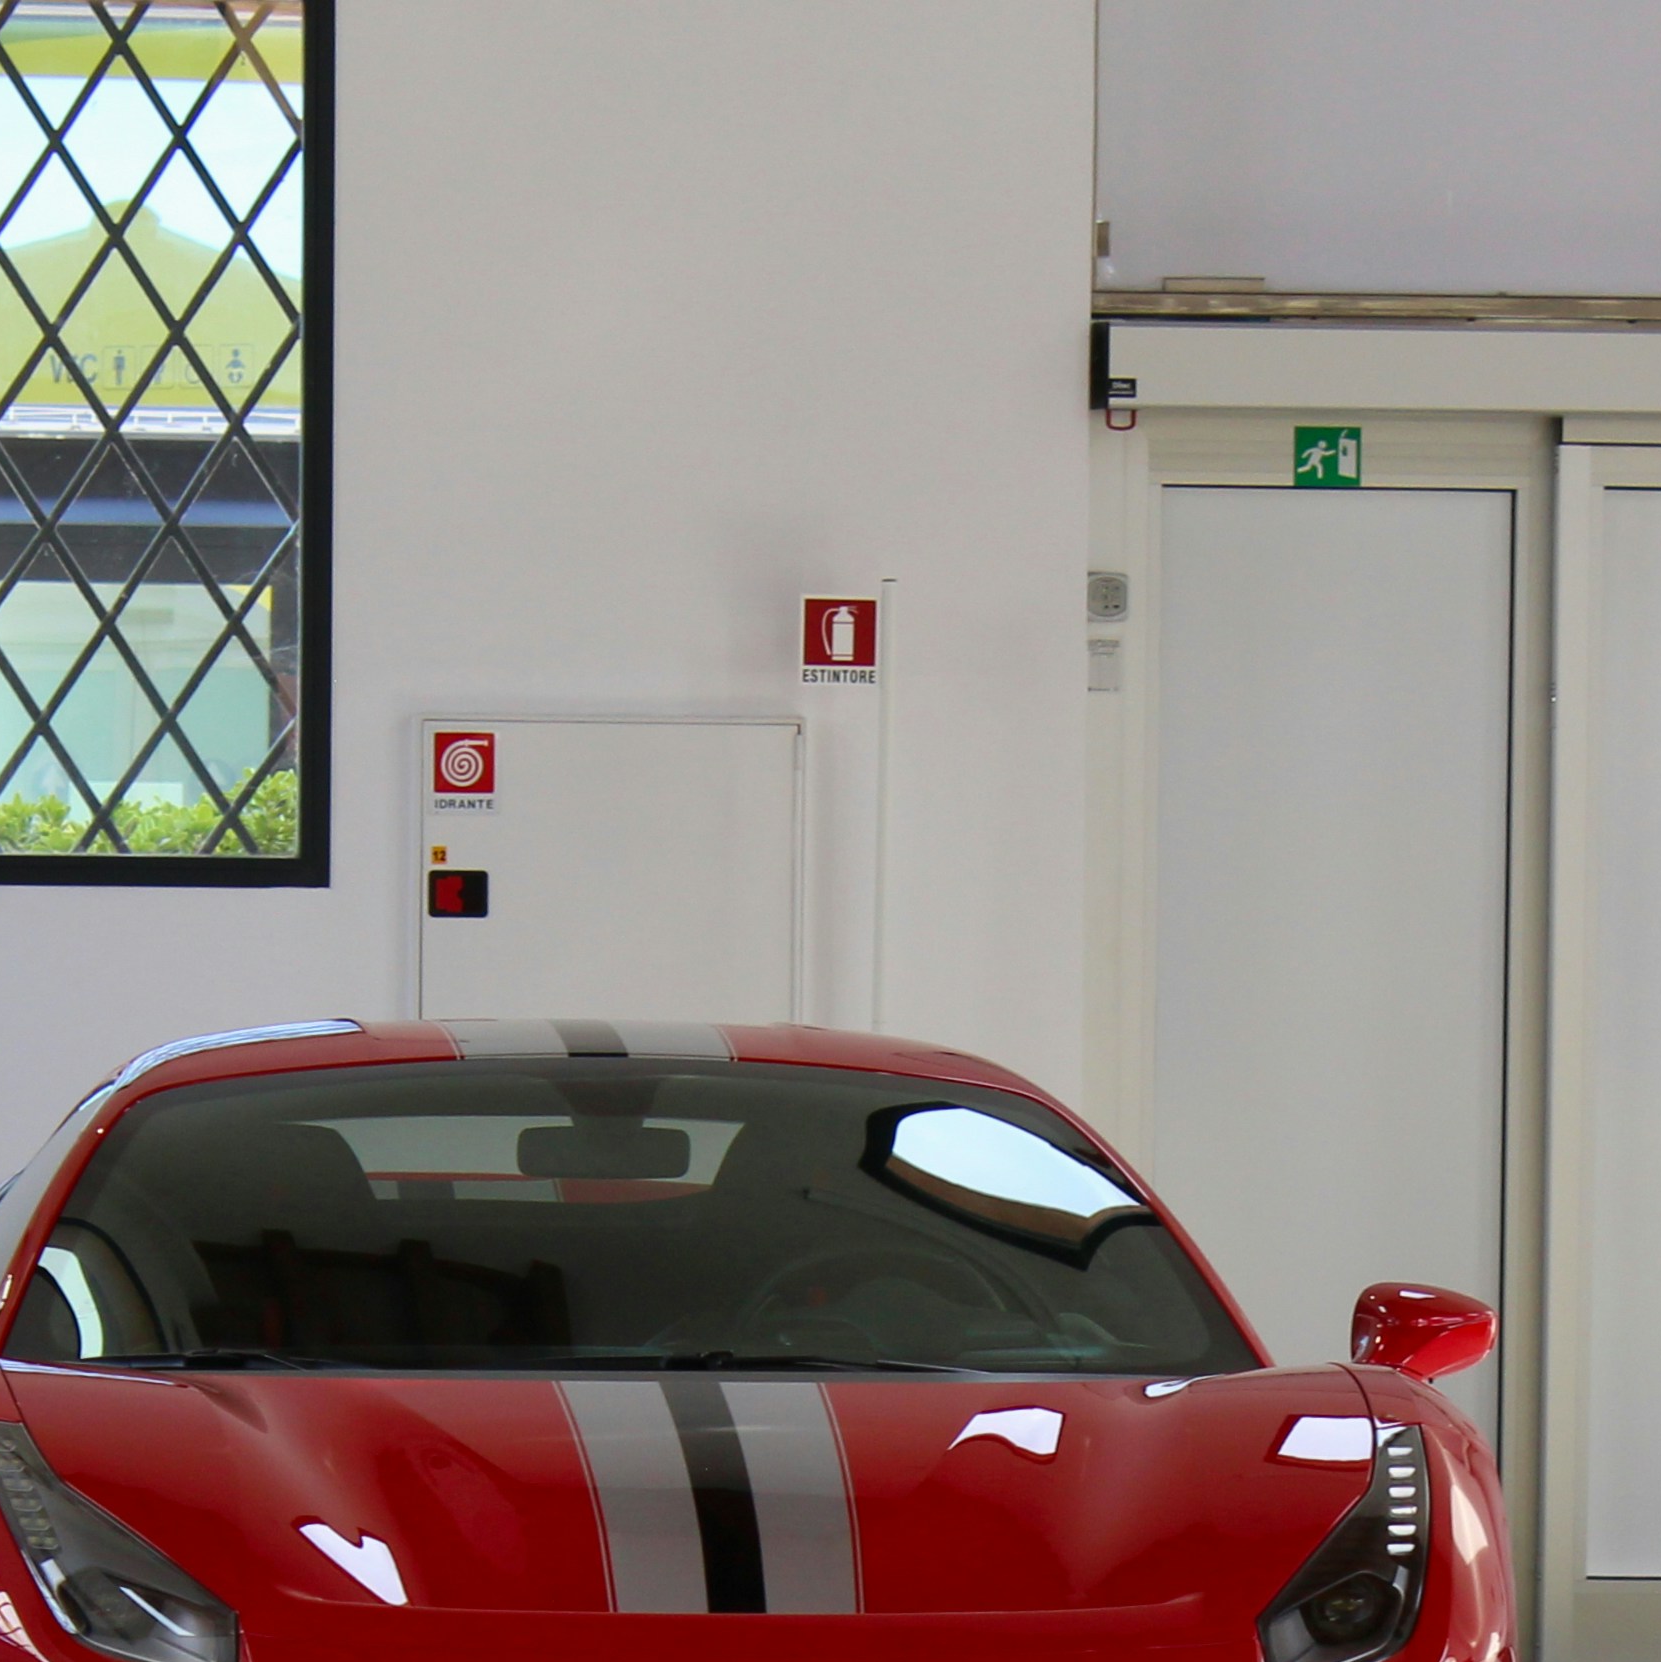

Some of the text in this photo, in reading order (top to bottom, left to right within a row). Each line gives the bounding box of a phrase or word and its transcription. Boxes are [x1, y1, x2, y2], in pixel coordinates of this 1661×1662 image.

[50, 352, 98, 384] WC
[802, 668, 876, 684] ESTINTORE
[434, 799, 494, 810] IDRANTE
